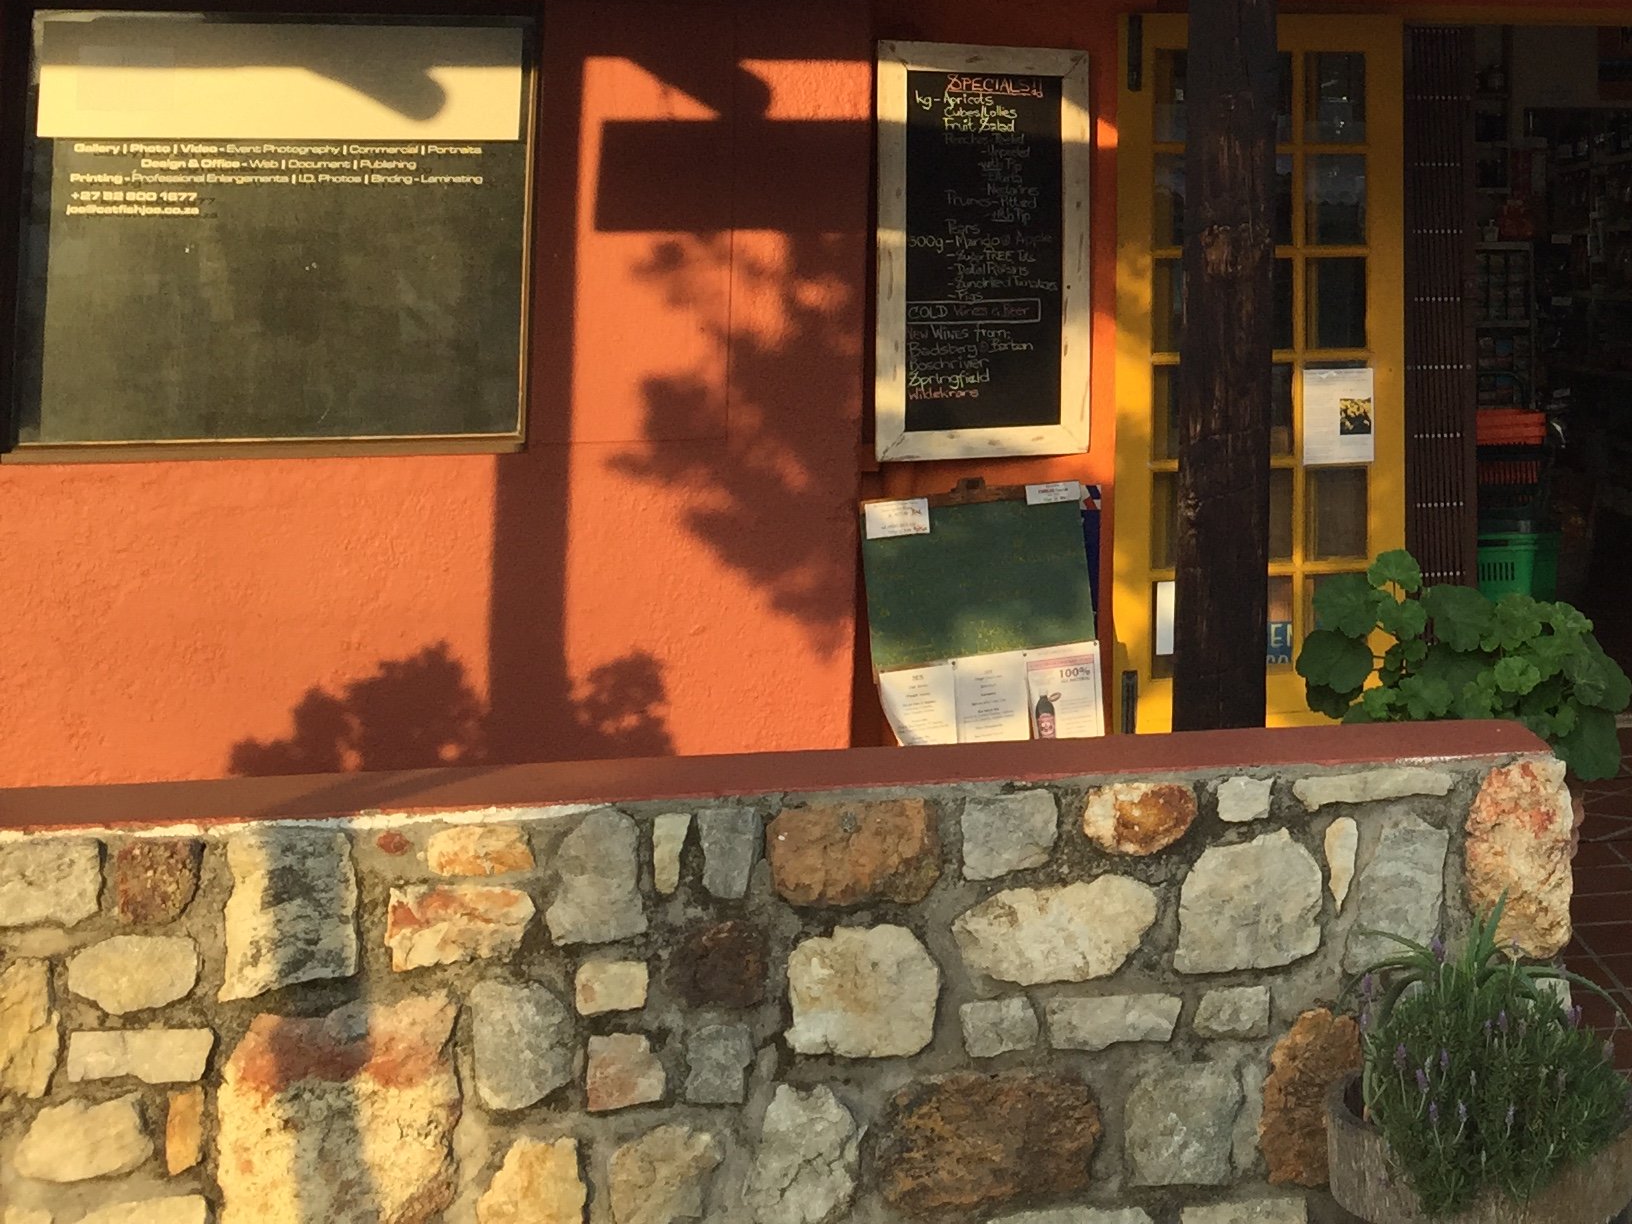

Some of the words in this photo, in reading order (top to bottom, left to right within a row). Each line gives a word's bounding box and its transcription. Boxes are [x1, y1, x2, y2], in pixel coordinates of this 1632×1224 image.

[942, 117, 976, 133] Fruit
[977, 117, 1016, 134] Salad
[74, 143, 120, 156] Gallery
[130, 143, 171, 154] Photo
[180, 143, 218, 154] Video
[226, 144, 261, 154] Event
[263, 144, 340, 156] Photography
[349, 145, 419, 155] Commercial
[427, 145, 482, 155] Portraits
[140, 158, 186, 170] Design
[200, 158, 240, 169] Office
[249, 159, 279, 169] Web
[288, 160, 351, 169] Document
[360, 160, 417, 171] Publishing
[69, 173, 123, 185] Printing
[131, 173, 206, 184] Professional
[206, 174, 289, 185] Enlargements
[318, 174, 361, 184] Photos
[420, 174, 483, 185] Laminating
[908, 305, 949, 319] COLD
[908, 367, 990, 390] Springfield
